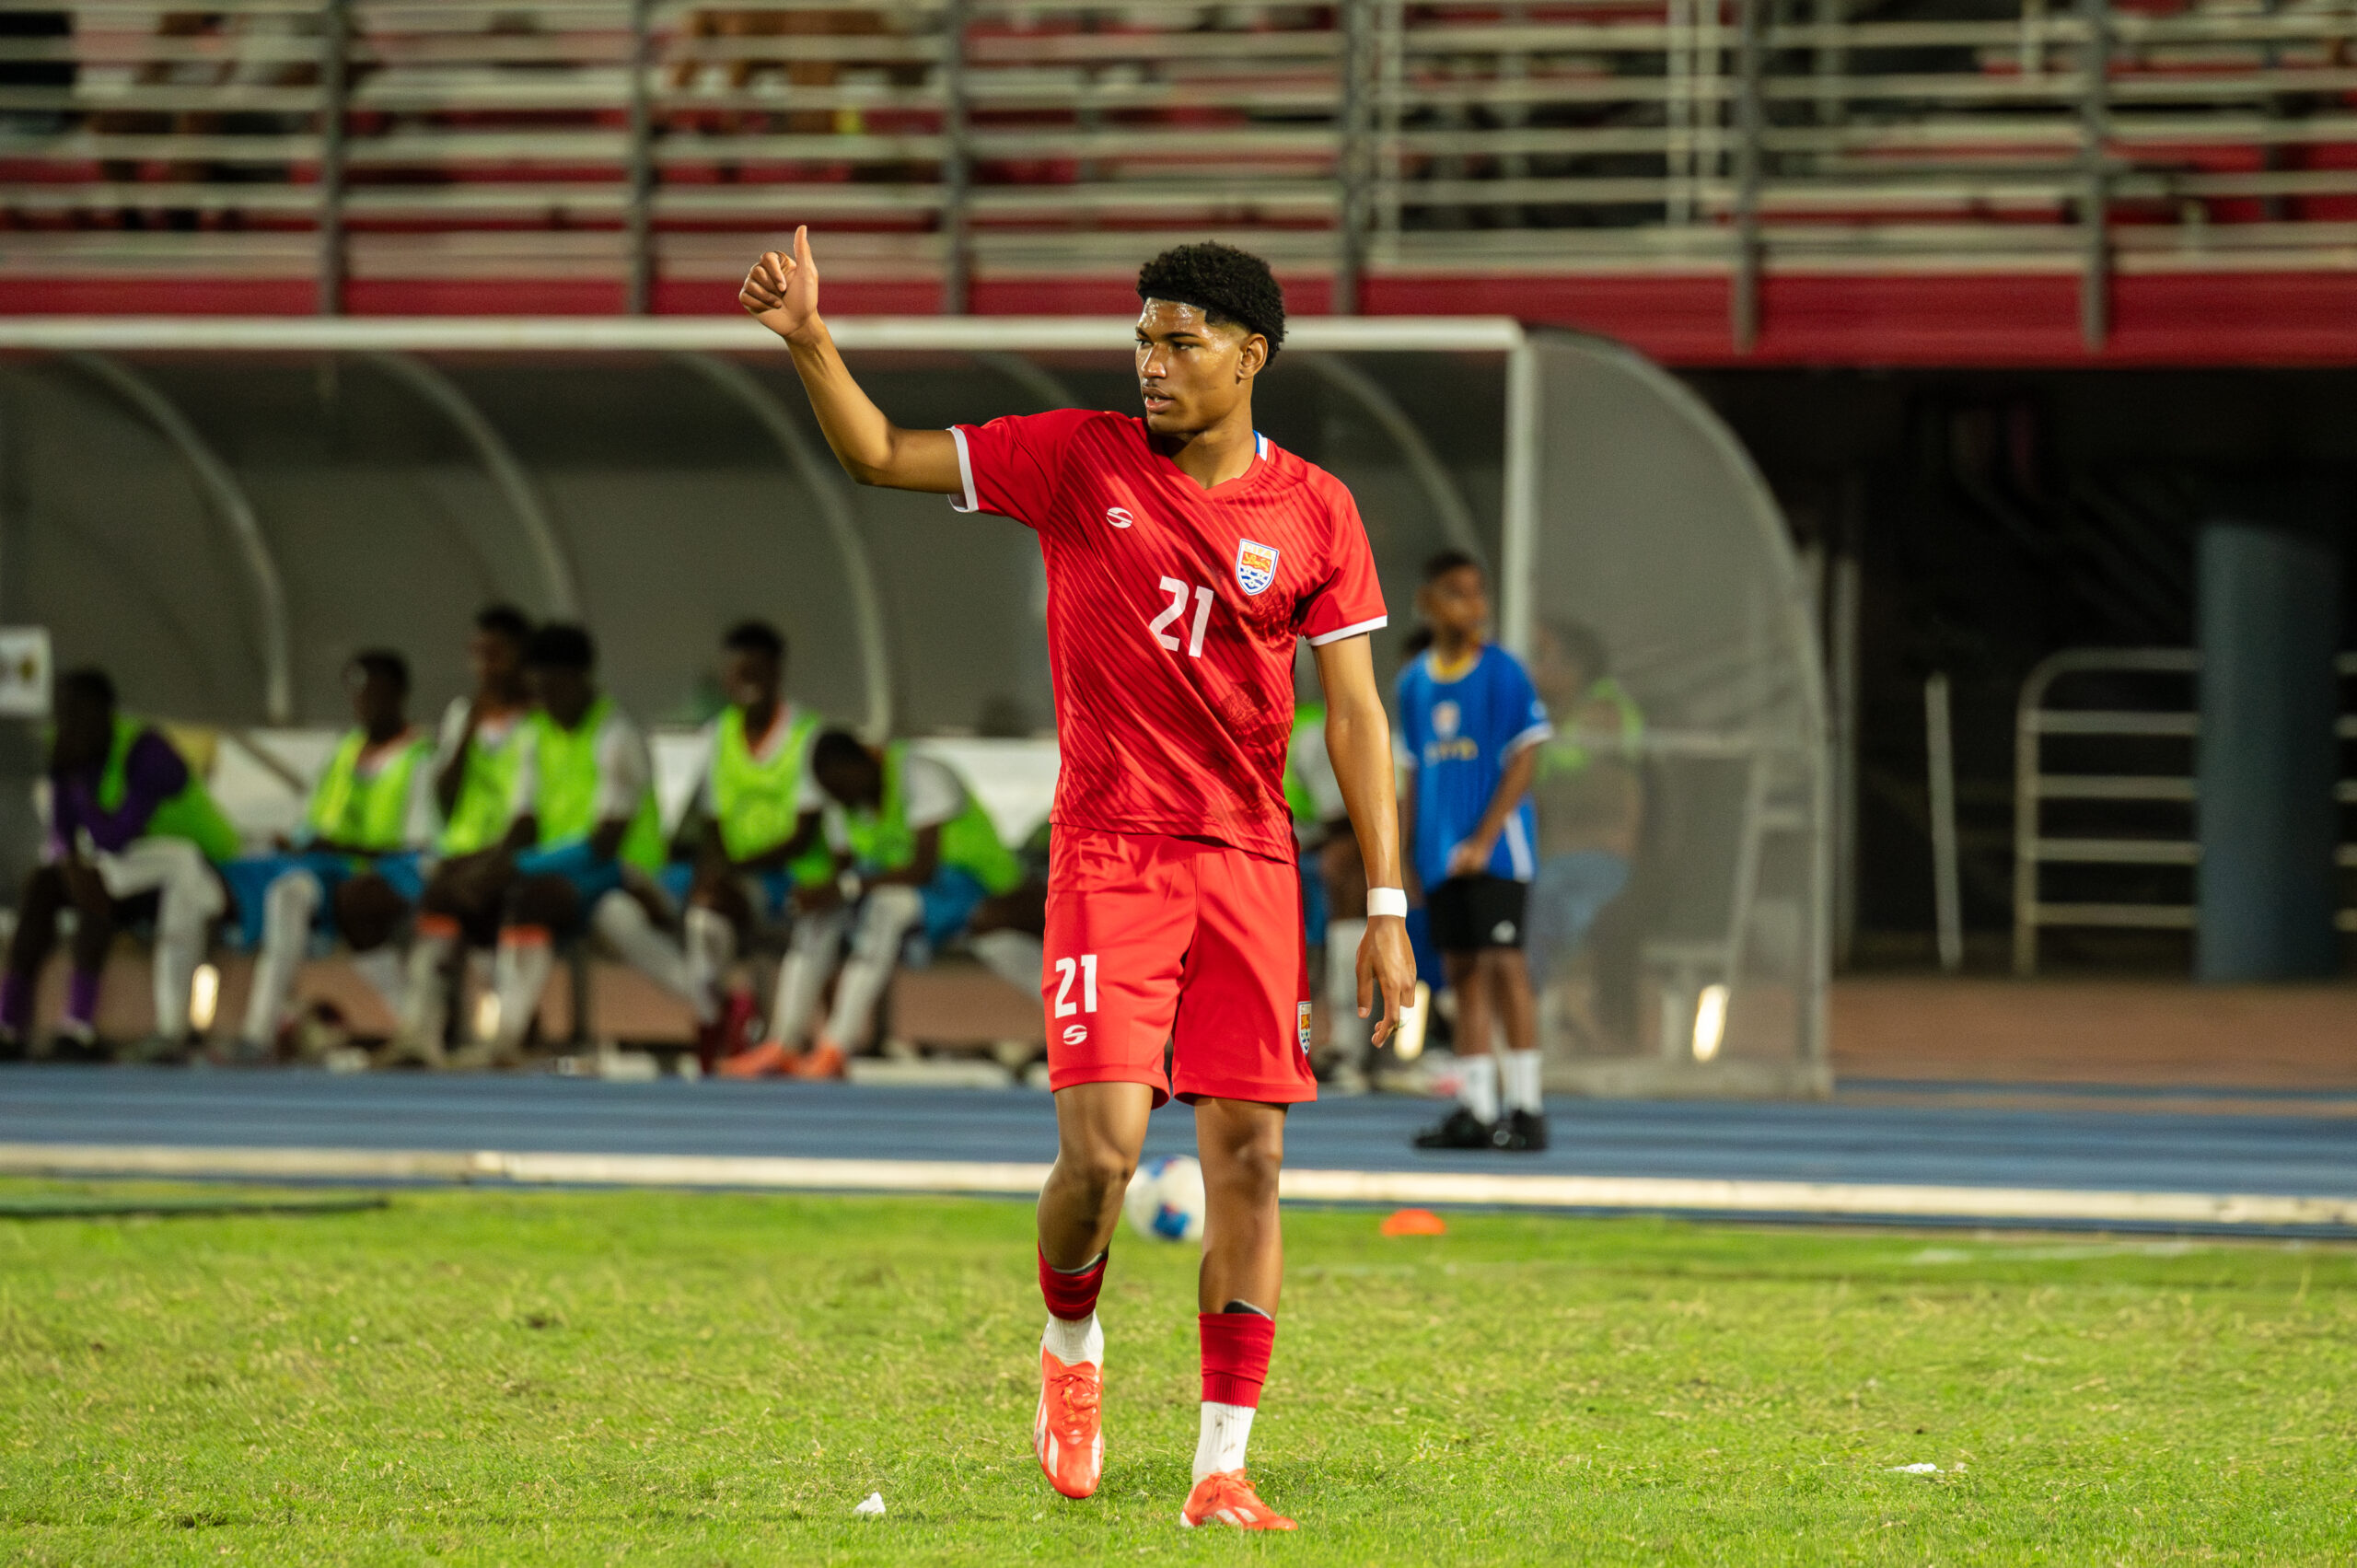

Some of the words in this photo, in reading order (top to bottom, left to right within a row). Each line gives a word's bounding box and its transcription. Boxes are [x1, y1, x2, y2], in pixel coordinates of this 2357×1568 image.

[1244, 543, 1272, 558] CIFA
[1149, 575, 1214, 658] 21
[1055, 954, 1097, 1018] 21
